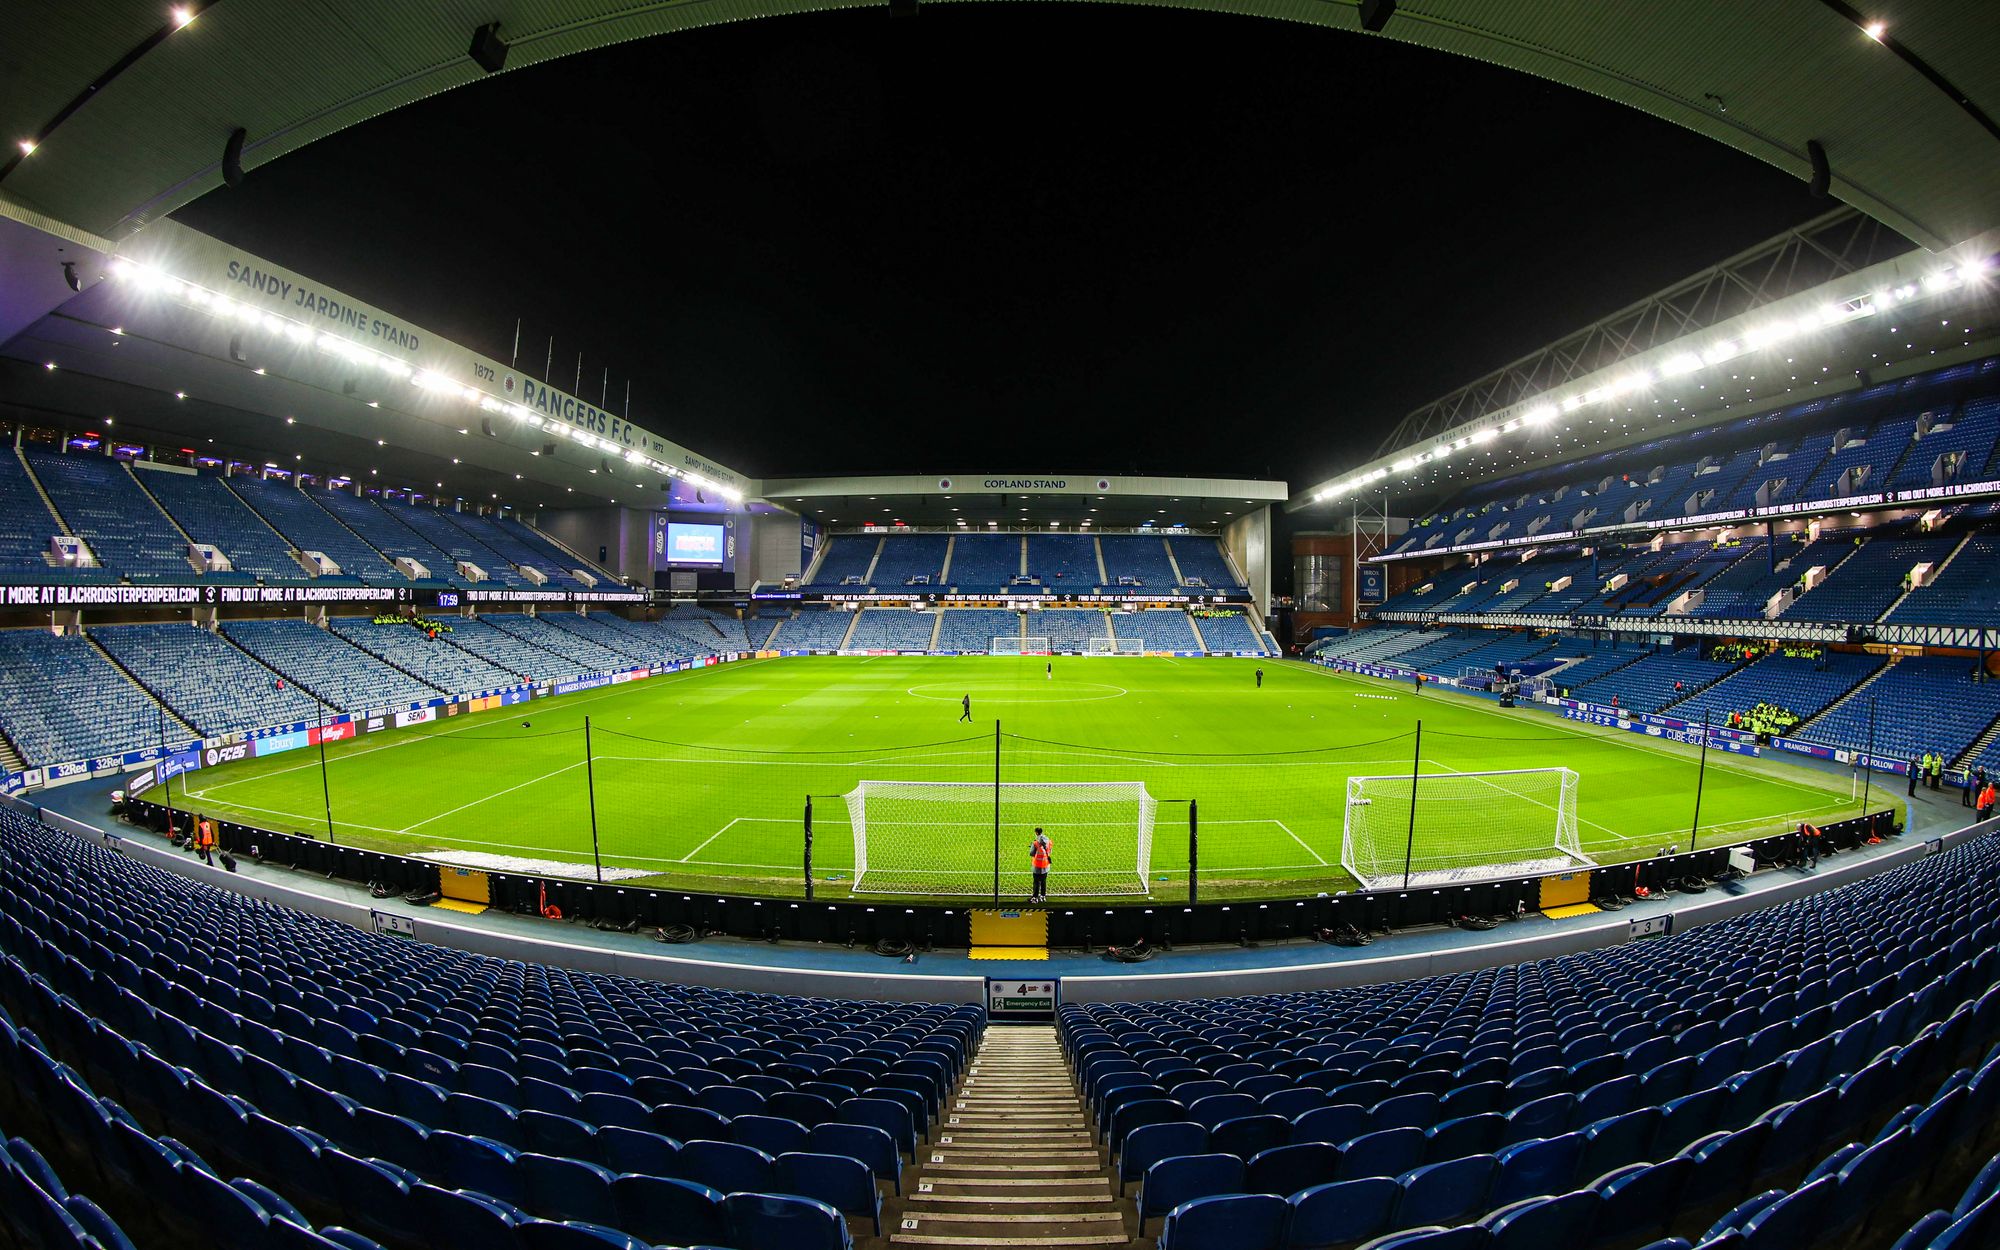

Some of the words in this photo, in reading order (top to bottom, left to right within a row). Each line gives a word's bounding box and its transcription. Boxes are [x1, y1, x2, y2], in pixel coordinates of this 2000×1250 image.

[227, 261, 291, 300] SANDY
[295, 288, 367, 331] JARDINE
[371, 320, 419, 351] STAND
[474, 363, 494, 382] 1872
[523, 379, 606, 433] RANGERS
[612, 418, 635, 447] F.C.
[652, 440, 664, 453] 1872
[685, 455, 700, 469] SANDY
[984, 480, 1031, 488] COPLAND
[1033, 480, 1066, 488] STAND
[1898, 491, 1911, 500] FIND
[1913, 489, 1925, 499] OUT
[1926, 486, 1944, 497] MORE
[1945, 486, 1954, 496] AT
[1757, 507, 1767, 515] FIND
[1769, 506, 1779, 515] OUT
[1780, 504, 1794, 513] MORE
[1795, 503, 1801, 511] AT
[8, 587, 39, 604] MORE
[41, 587, 55, 603] AT
[57, 587, 200, 603] BLACKROOSTERPERIPERI.COM
[222, 588, 241, 602] FIND
[242, 588, 259, 601] OUT
[261, 588, 283, 601] MORE
[284, 588, 295, 601] AT
[296, 588, 394, 601] BLACKROOSTERPERIPERI.COM
[440, 594, 458, 606] 17:59
[467, 591, 478, 600] FIND
[478, 591, 488, 600] OUT
[489, 592, 502, 600] MORE
[503, 592, 509, 600] AT
[558, 682, 579, 694] RANGERS
[580, 678, 600, 689] FOOTBALL
[368, 708, 386, 719] RHINO
[388, 704, 411, 715] EXPRESS
[270, 737, 293, 750] Ebury
[96, 755, 124, 769] 32Red
[1870, 759, 1894, 769] FOLLOW
[58, 762, 87, 776] 32Red
[1944, 773, 1957, 782] THIS
[392, 918, 398, 929] 5
[1644, 922, 1651, 932] 3
[1017, 984, 1027, 996] 4
